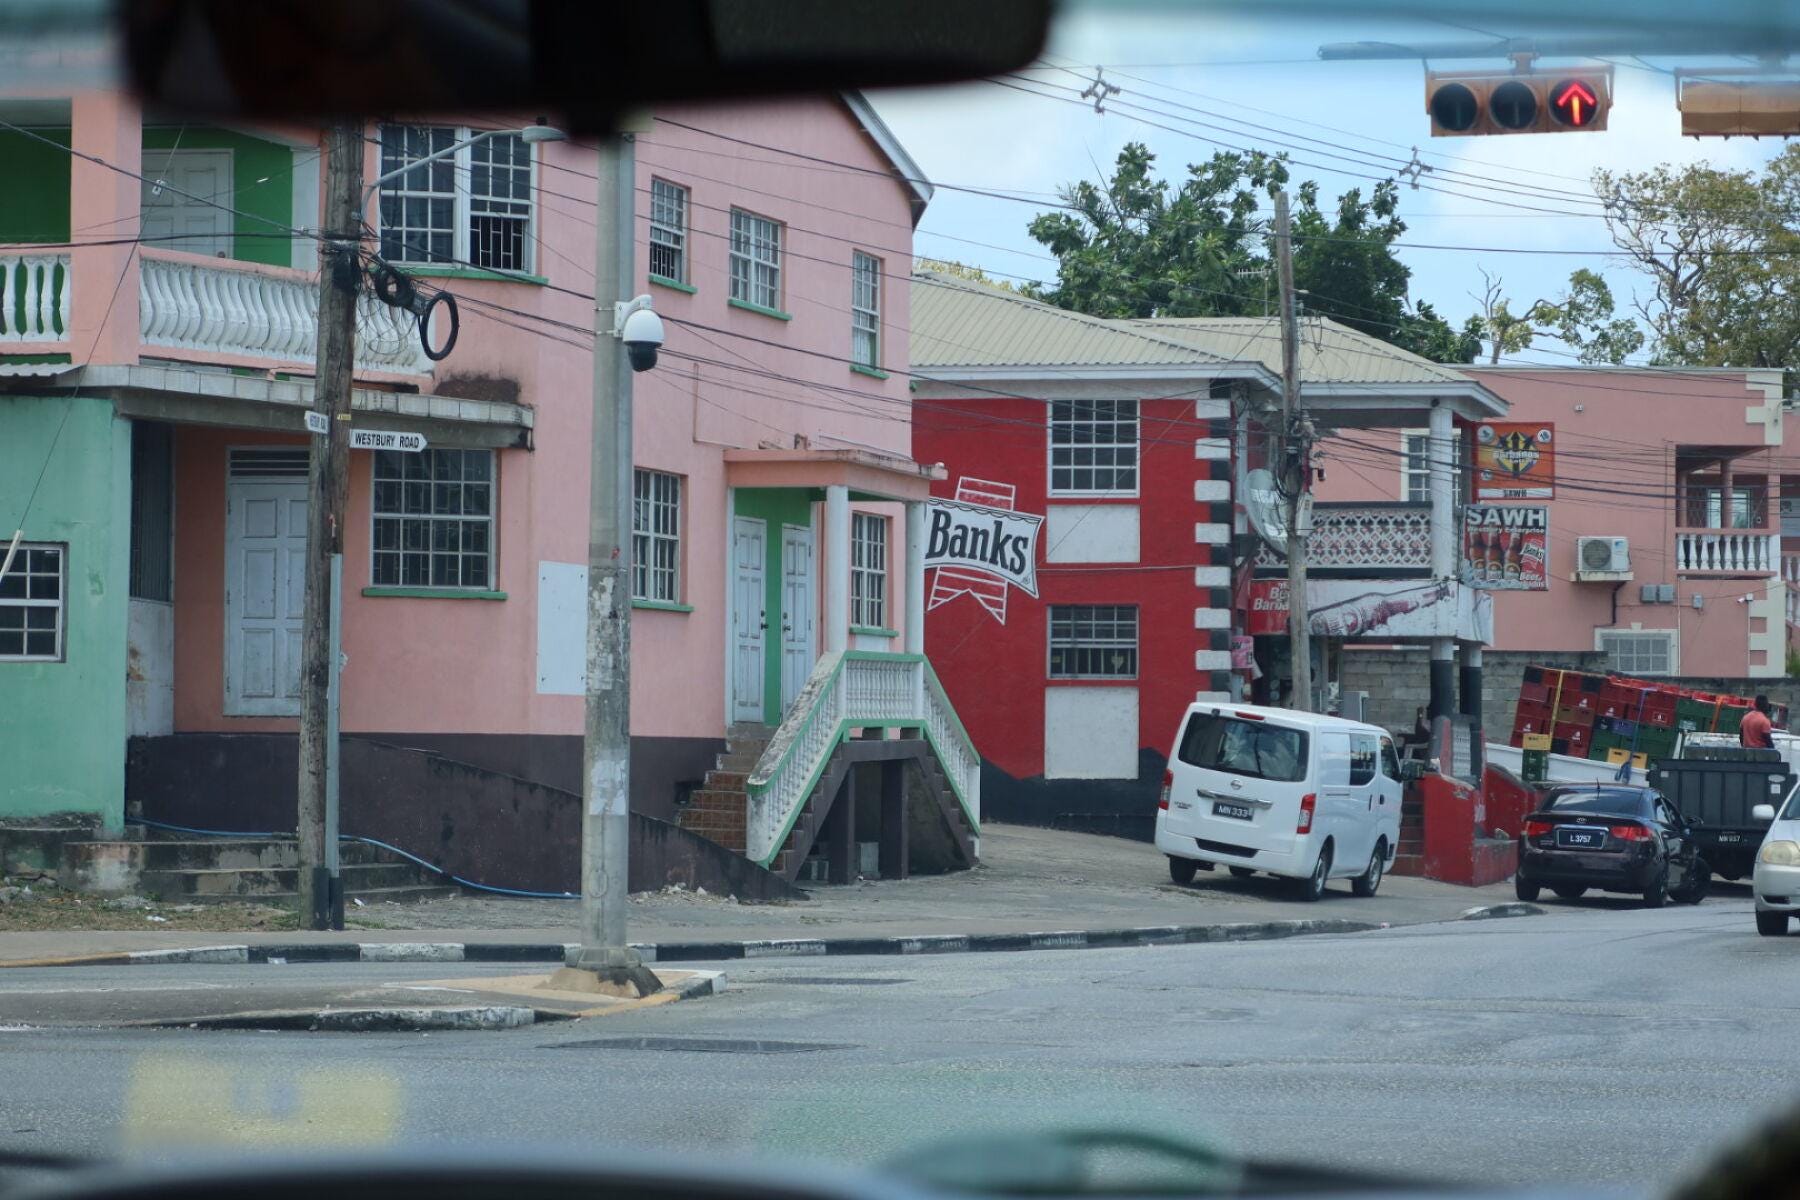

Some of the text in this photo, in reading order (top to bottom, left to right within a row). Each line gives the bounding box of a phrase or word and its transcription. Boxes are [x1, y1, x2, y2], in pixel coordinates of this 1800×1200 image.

[355, 433, 420, 448] WESTBURY ROAD
[1467, 508, 1545, 526] SAWH
[924, 508, 1030, 576] Banks
